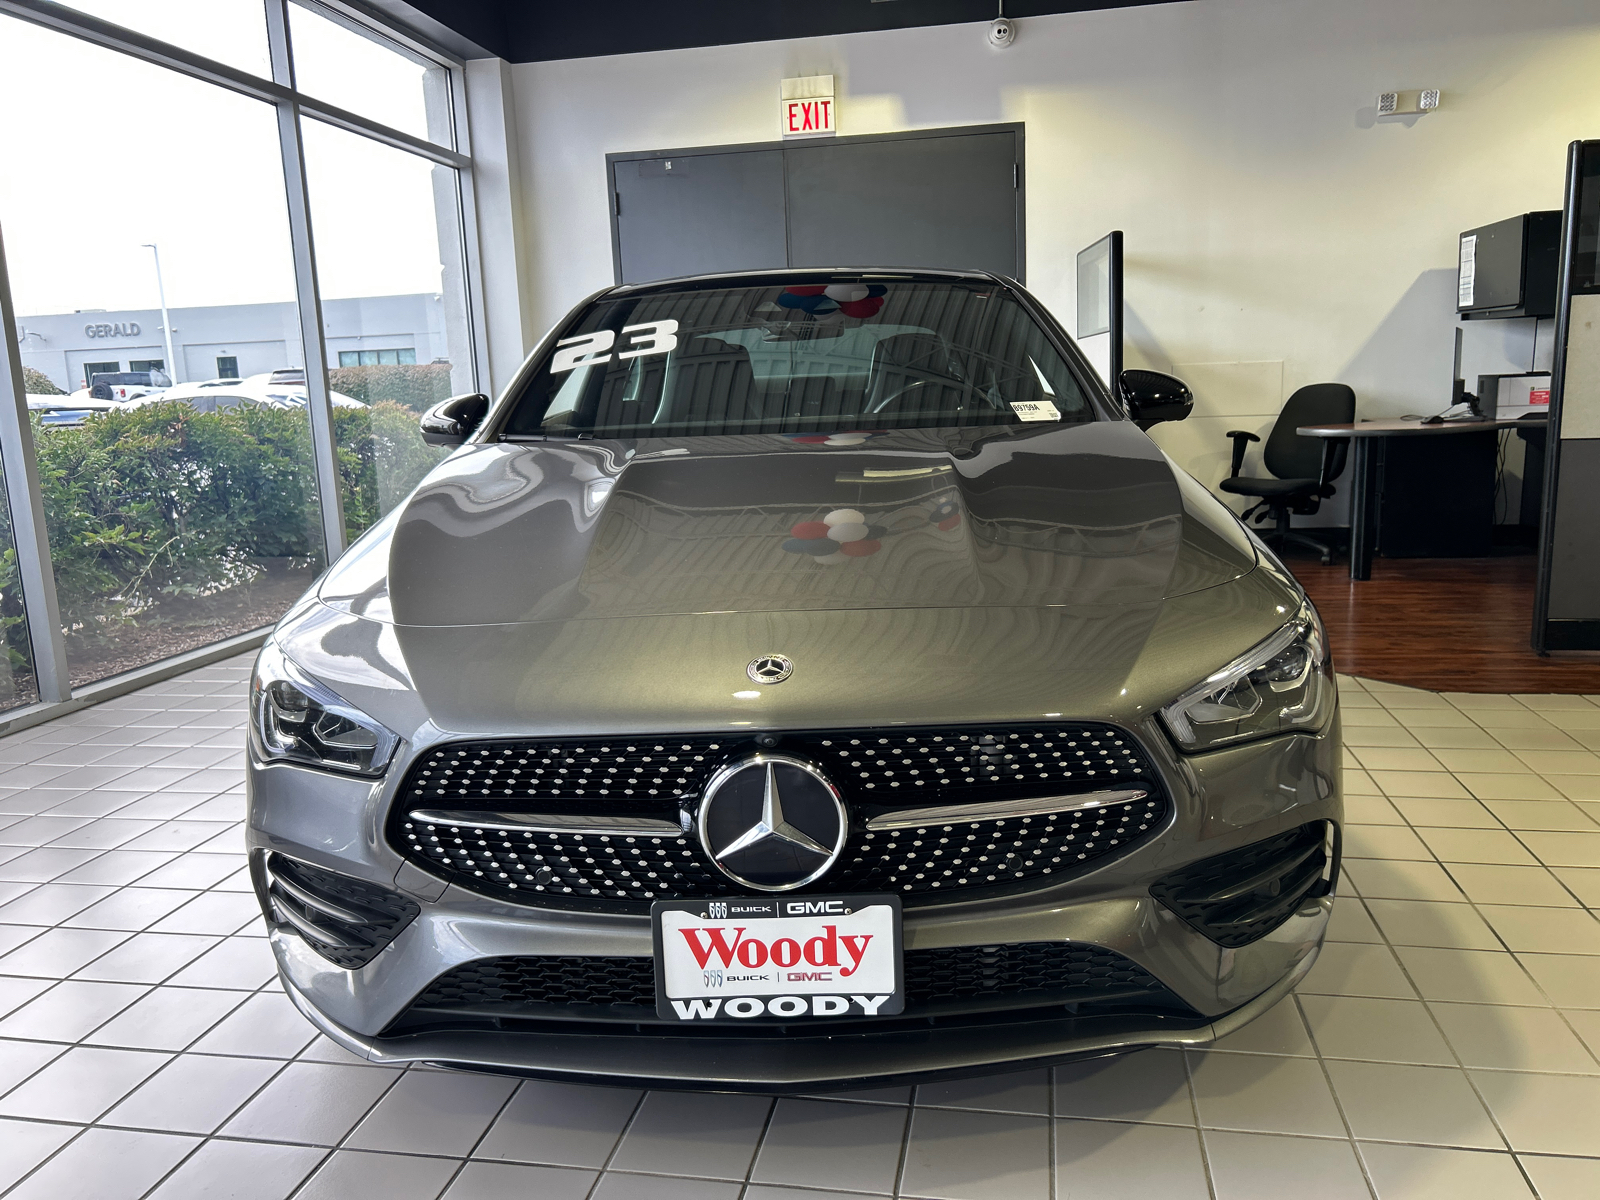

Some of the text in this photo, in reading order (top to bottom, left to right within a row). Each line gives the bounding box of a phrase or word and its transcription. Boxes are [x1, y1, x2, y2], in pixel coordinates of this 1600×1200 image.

[789, 101, 830, 131] EXIT
[84, 322, 141, 338] GERALD
[550, 319, 679, 374] 23
[731, 901, 844, 915] BUICK GMC
[678, 925, 874, 977] Woody
[726, 971, 833, 982] BUICK GMC
[670, 995, 890, 1020] WOODY
